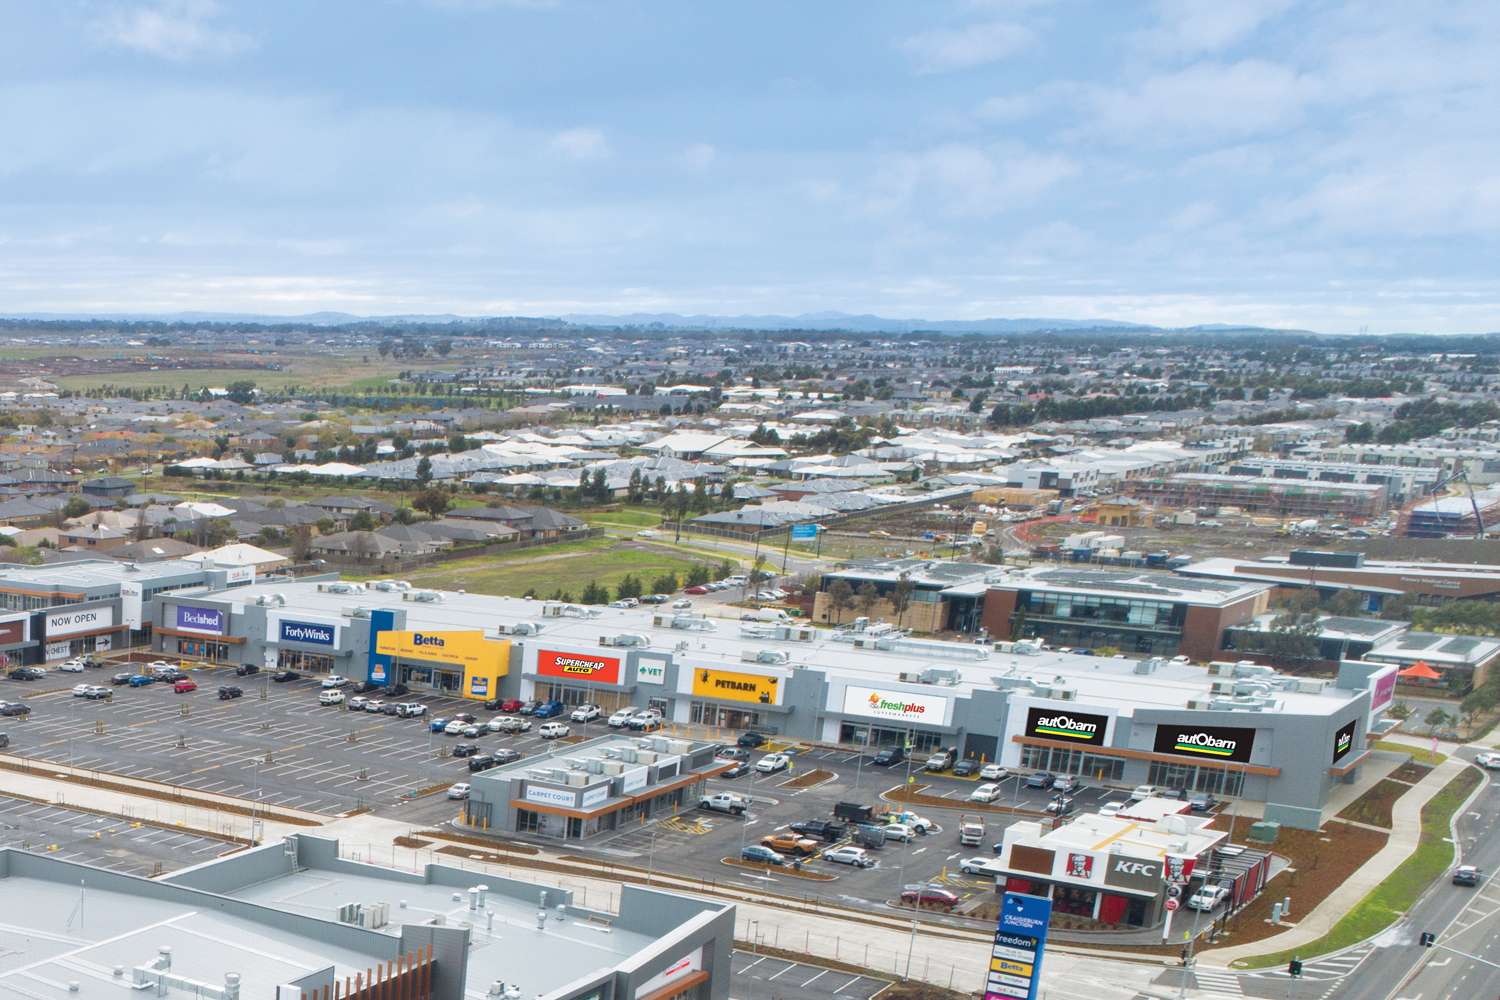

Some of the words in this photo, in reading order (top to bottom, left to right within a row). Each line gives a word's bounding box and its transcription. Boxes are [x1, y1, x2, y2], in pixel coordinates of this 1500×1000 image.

[51, 617, 72, 627] NOW
[74, 613, 97, 624] OPEN
[184, 612, 219, 626] Bedshed
[413, 633, 445, 646] Betta
[554, 656, 605, 671] SUPERCHEAP
[647, 667, 663, 677] VET
[715, 678, 756, 692] PETBARN
[879, 700, 925, 714] freshplus
[528, 790, 552, 799] CARPET
[552, 793, 575, 803] COURT
[1114, 860, 1156, 877] KFC
[1004, 915, 1043, 925] CRAIGIEBURN
[1004, 920, 1033, 928] JUNCTION
[996, 934, 1031, 946] freedom
[1000, 962, 1023, 971] Betta
